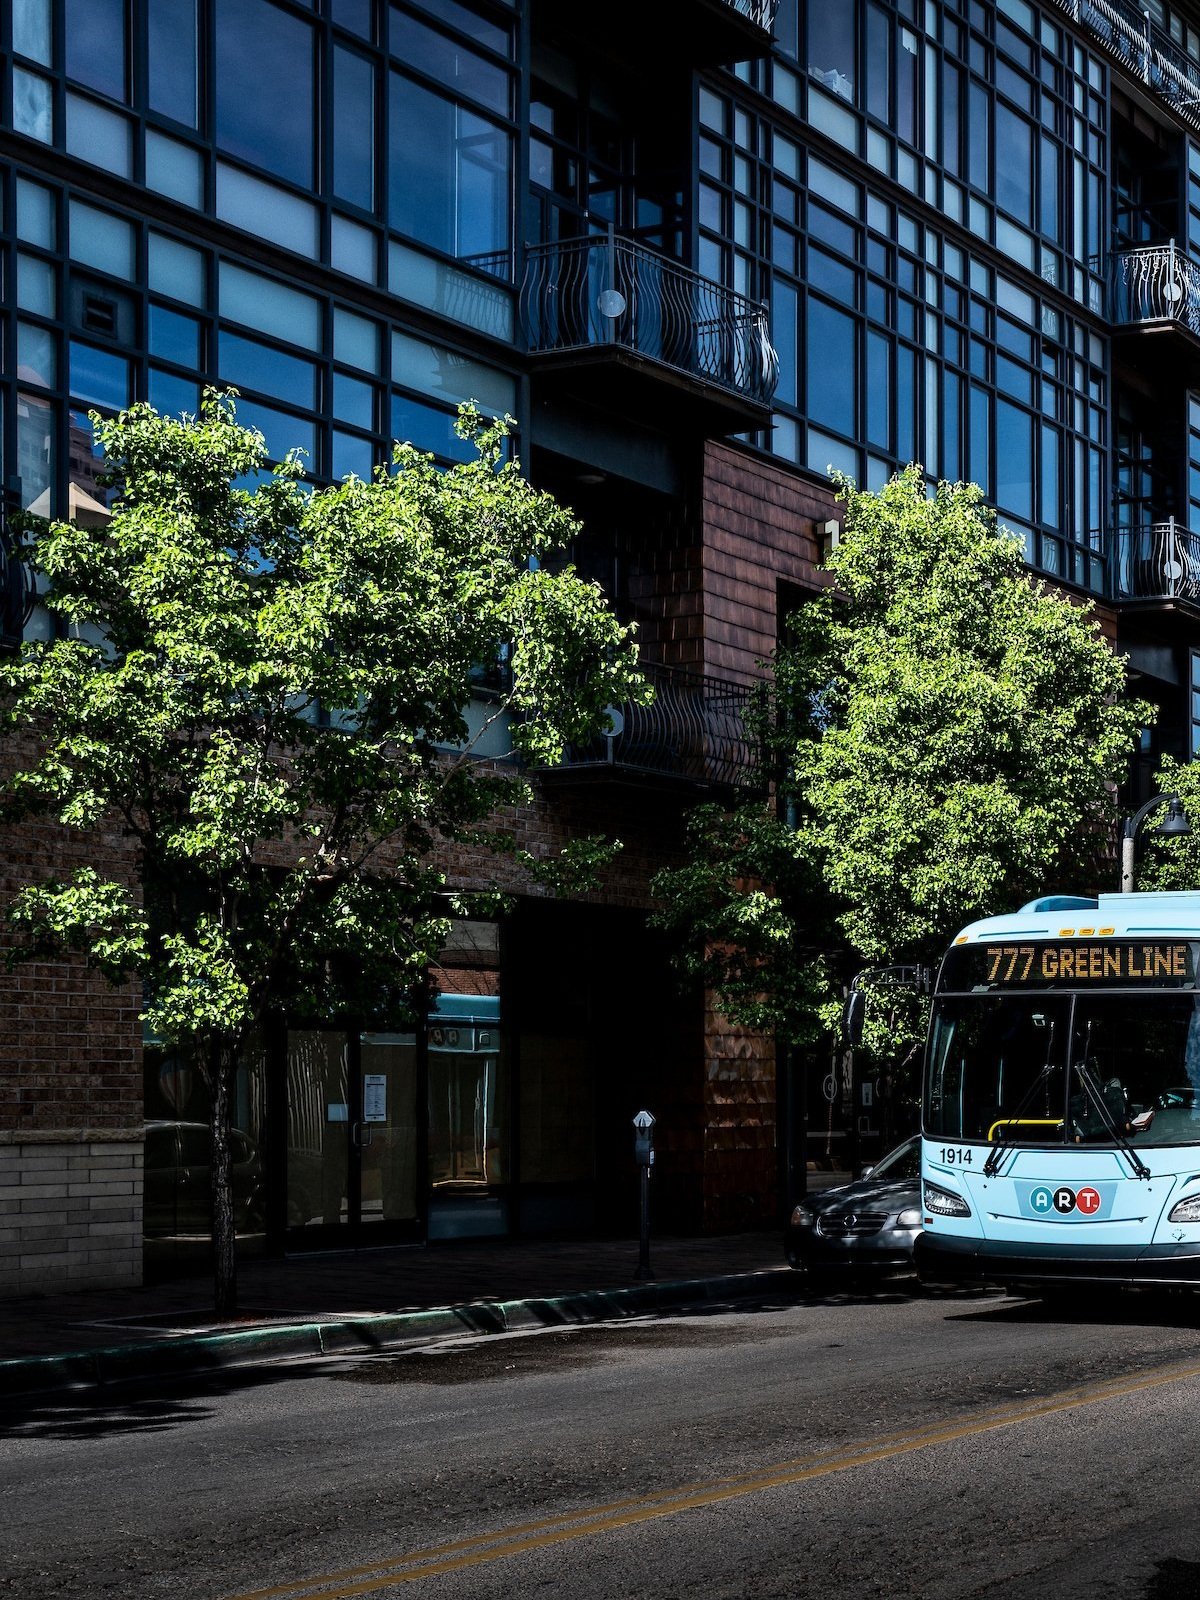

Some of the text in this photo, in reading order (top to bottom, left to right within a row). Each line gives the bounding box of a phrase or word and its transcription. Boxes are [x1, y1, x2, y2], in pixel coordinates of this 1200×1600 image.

[987, 945, 1187, 981] 777 GREEN LINE
[940, 1148, 973, 1164] 1914
[1033, 1190, 1098, 1210] ART
